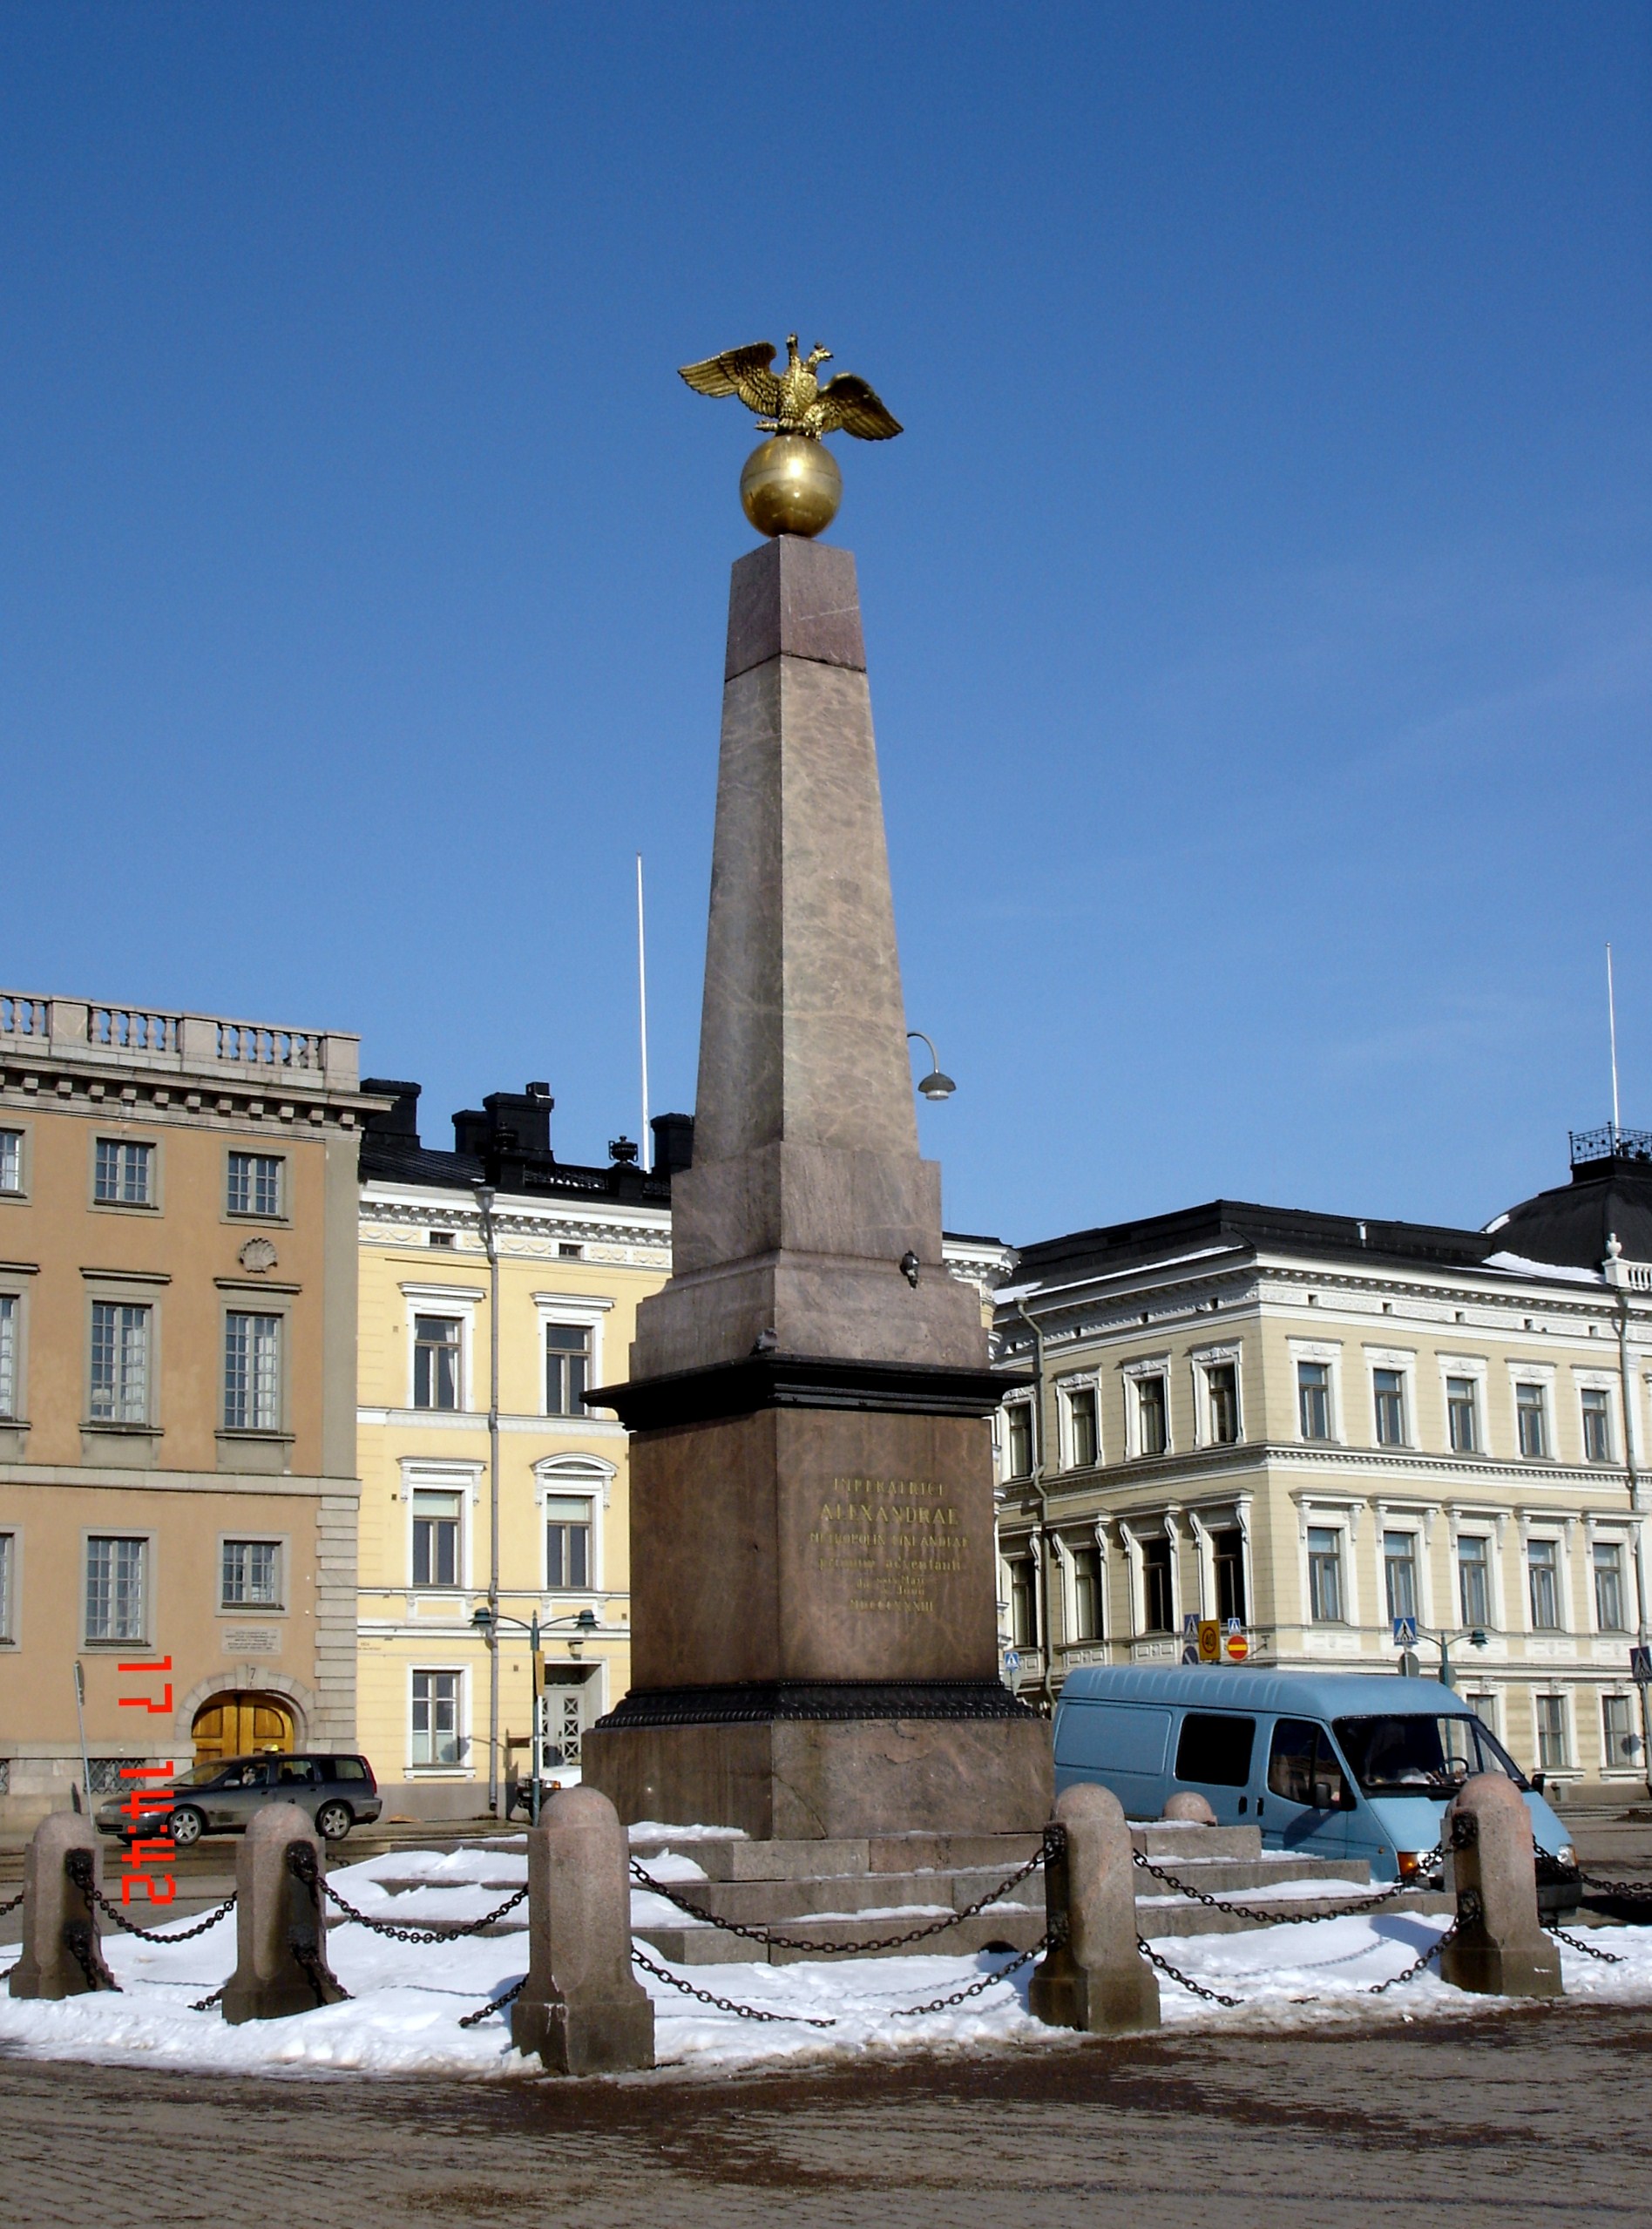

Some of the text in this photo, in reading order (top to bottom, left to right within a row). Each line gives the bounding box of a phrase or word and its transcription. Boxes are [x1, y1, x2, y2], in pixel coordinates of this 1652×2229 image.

[834, 1478, 943, 1496] IMPERATRICI
[821, 1504, 958, 1525] ALEXANDRAE
[250, 1667, 256, 1680] 7
